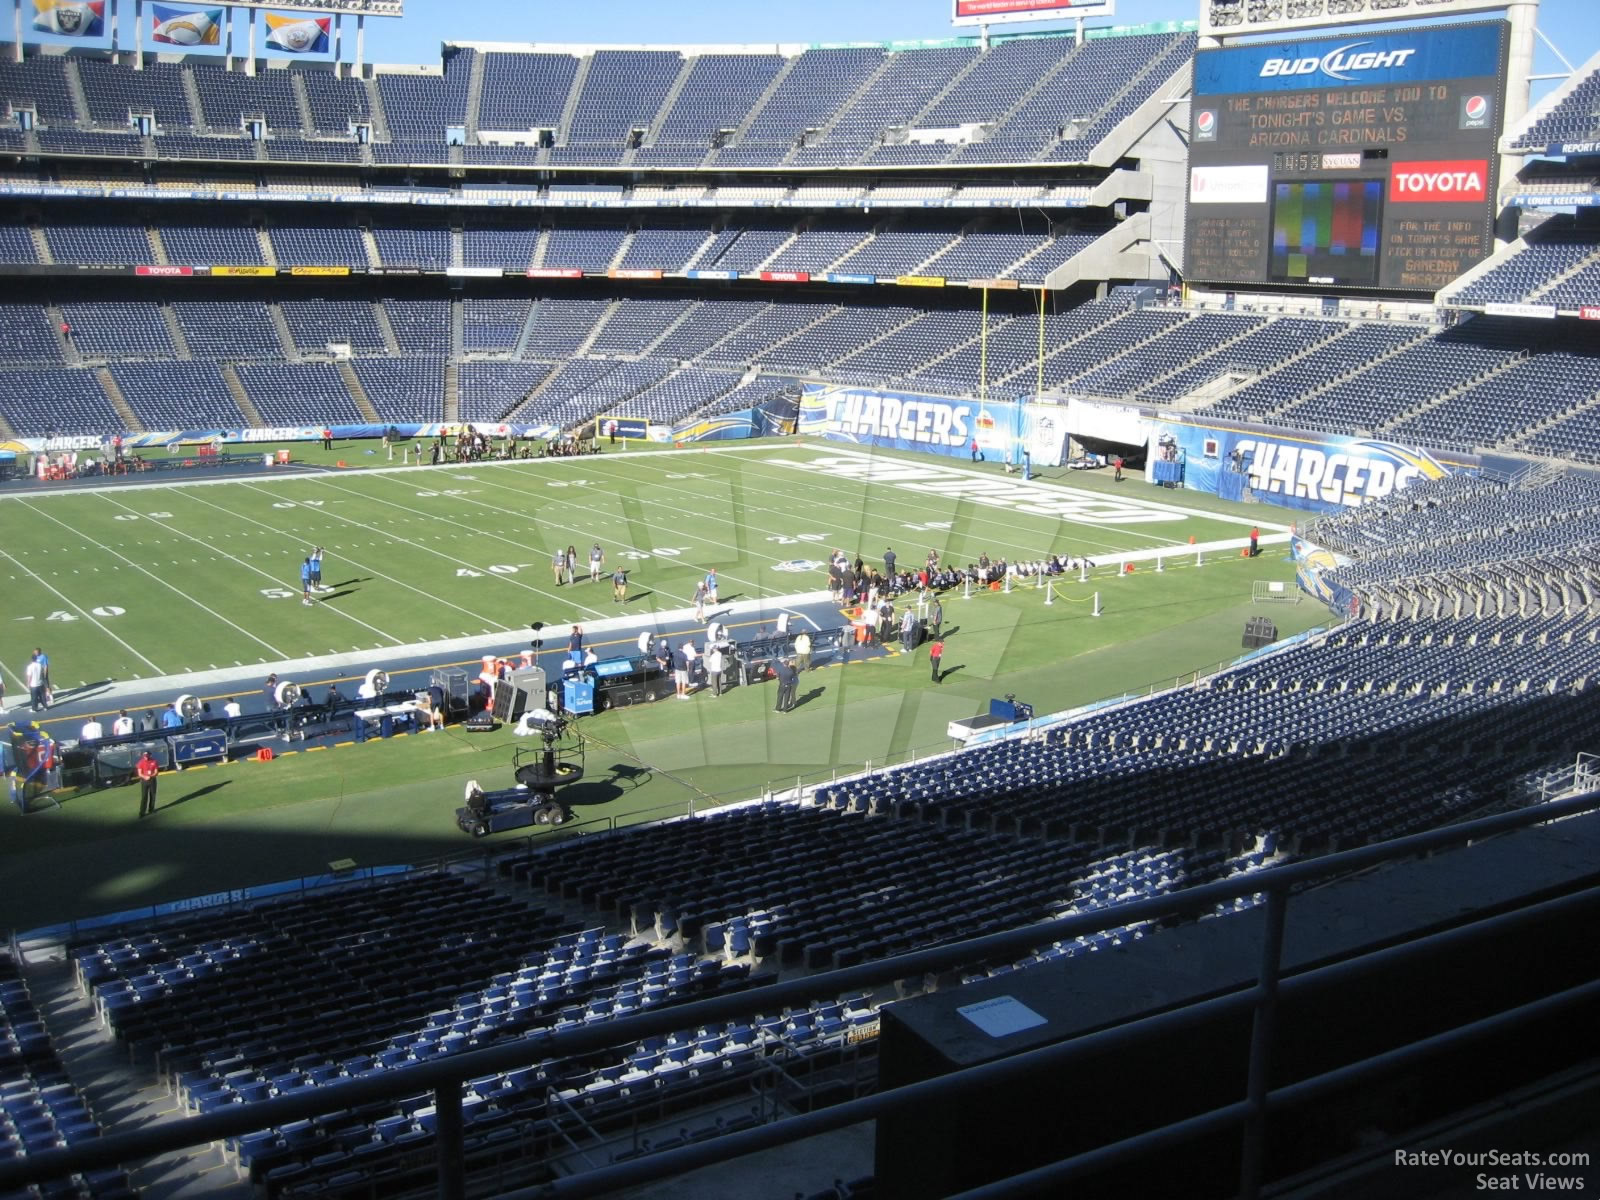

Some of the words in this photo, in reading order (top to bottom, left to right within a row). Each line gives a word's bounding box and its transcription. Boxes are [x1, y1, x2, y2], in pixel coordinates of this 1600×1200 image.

[1259, 58, 1322, 77] BUD
[1330, 49, 1416, 74] LIGHT
[1228, 98, 1249, 111] THE
[1257, 94, 1319, 110] CHARGERS
[1326, 90, 1386, 106] WELCOME
[1394, 87, 1420, 102] YOU
[1429, 86, 1447, 100] TO
[1250, 111, 1325, 129] TONIGHT'S
[1331, 108, 1376, 125] GAME
[1383, 107, 1407, 123] VS.
[1465, 120, 1485, 129] pepsi
[1250, 131, 1310, 147] ARIZONA
[1318, 127, 1407, 145] CARDINALS
[1562, 143, 1594, 153] REPORT
[1323, 157, 1360, 166] SYCUAN
[1396, 171, 1481, 193] TOYOTA
[1527, 197, 1552, 205] LOUIE
[1553, 197, 1592, 205] KELCHER
[1400, 222, 1418, 231] FOR
[1424, 222, 1440, 231] THE
[1448, 222, 1471, 231] INFO
[1388, 248, 1411, 256] PICK
[1440, 248, 1463, 257] COPY
[1468, 249, 1480, 257] OF
[1406, 260, 1459, 272] GAMEDAY
[771, 272, 797, 280] TOYOTA
[827, 391, 971, 447] CHARGERS
[242, 427, 301, 441] CHARGERS
[40, 434, 102, 450] CHARGERS
[1236, 440, 1419, 507] CHARGERS
[766, 533, 825, 545] 20
[617, 547, 681, 560] 30
[456, 565, 519, 577] 40
[45, 606, 126, 621] 40
[260, 749, 271, 761] 40
